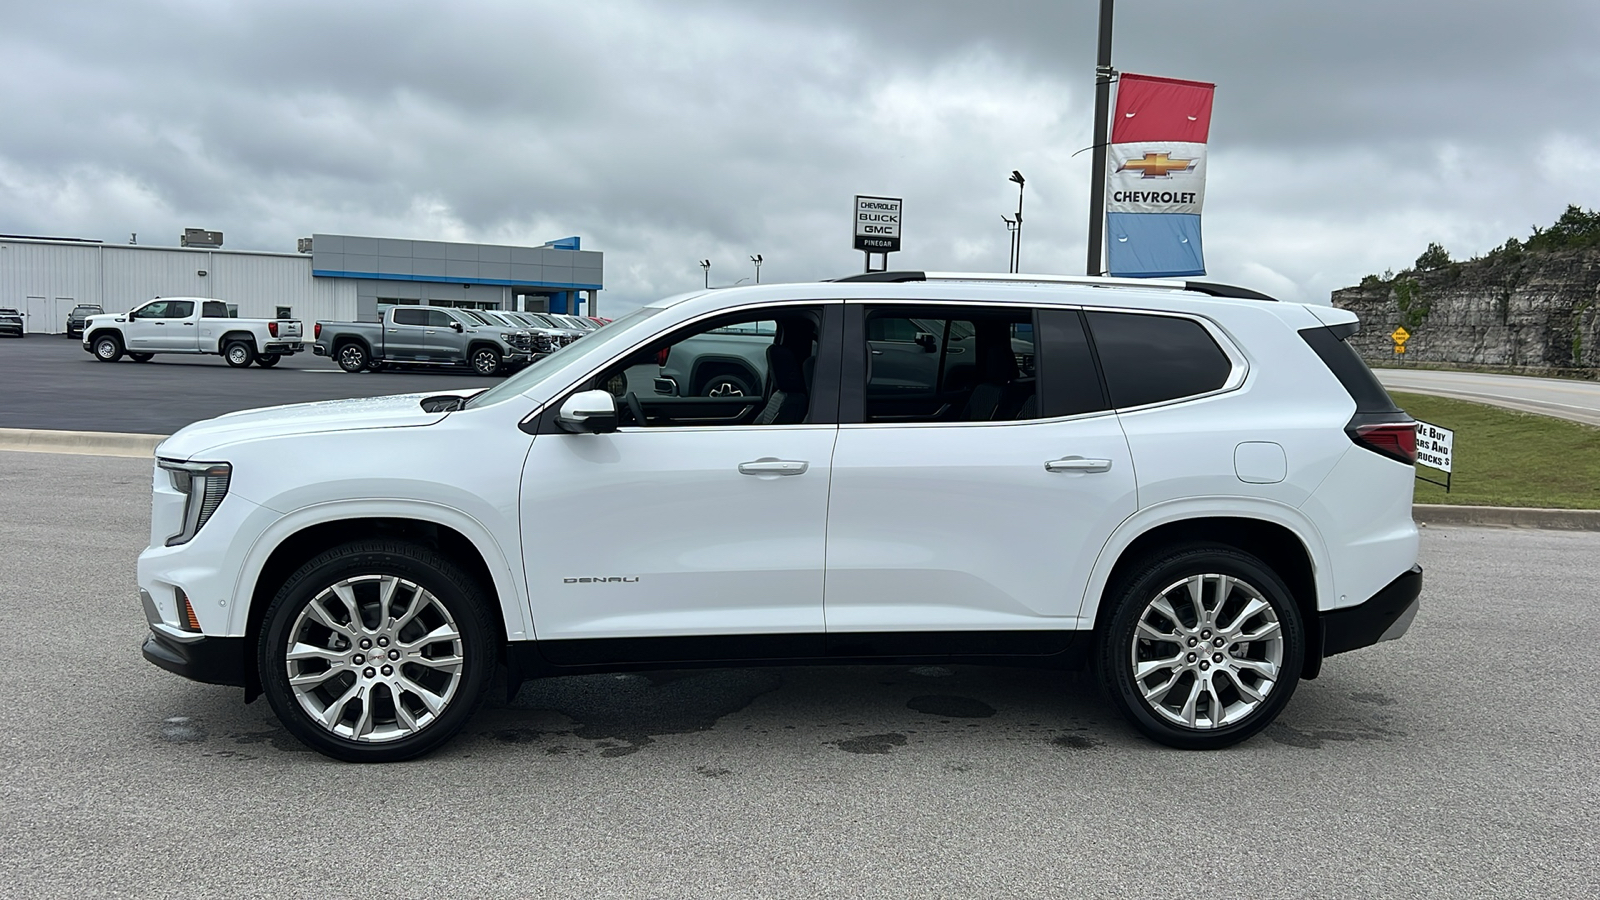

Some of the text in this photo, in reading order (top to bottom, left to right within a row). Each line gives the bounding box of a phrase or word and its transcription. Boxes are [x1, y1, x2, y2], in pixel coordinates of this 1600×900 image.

[1113, 191, 1196, 204] CHEVROLET
[860, 202, 898, 211] CHEVROLET
[859, 213, 898, 223] BUICK
[864, 225, 893, 234] GMC
[864, 239, 892, 247] PINEGAR
[1417, 451, 1442, 466] RUCKS
